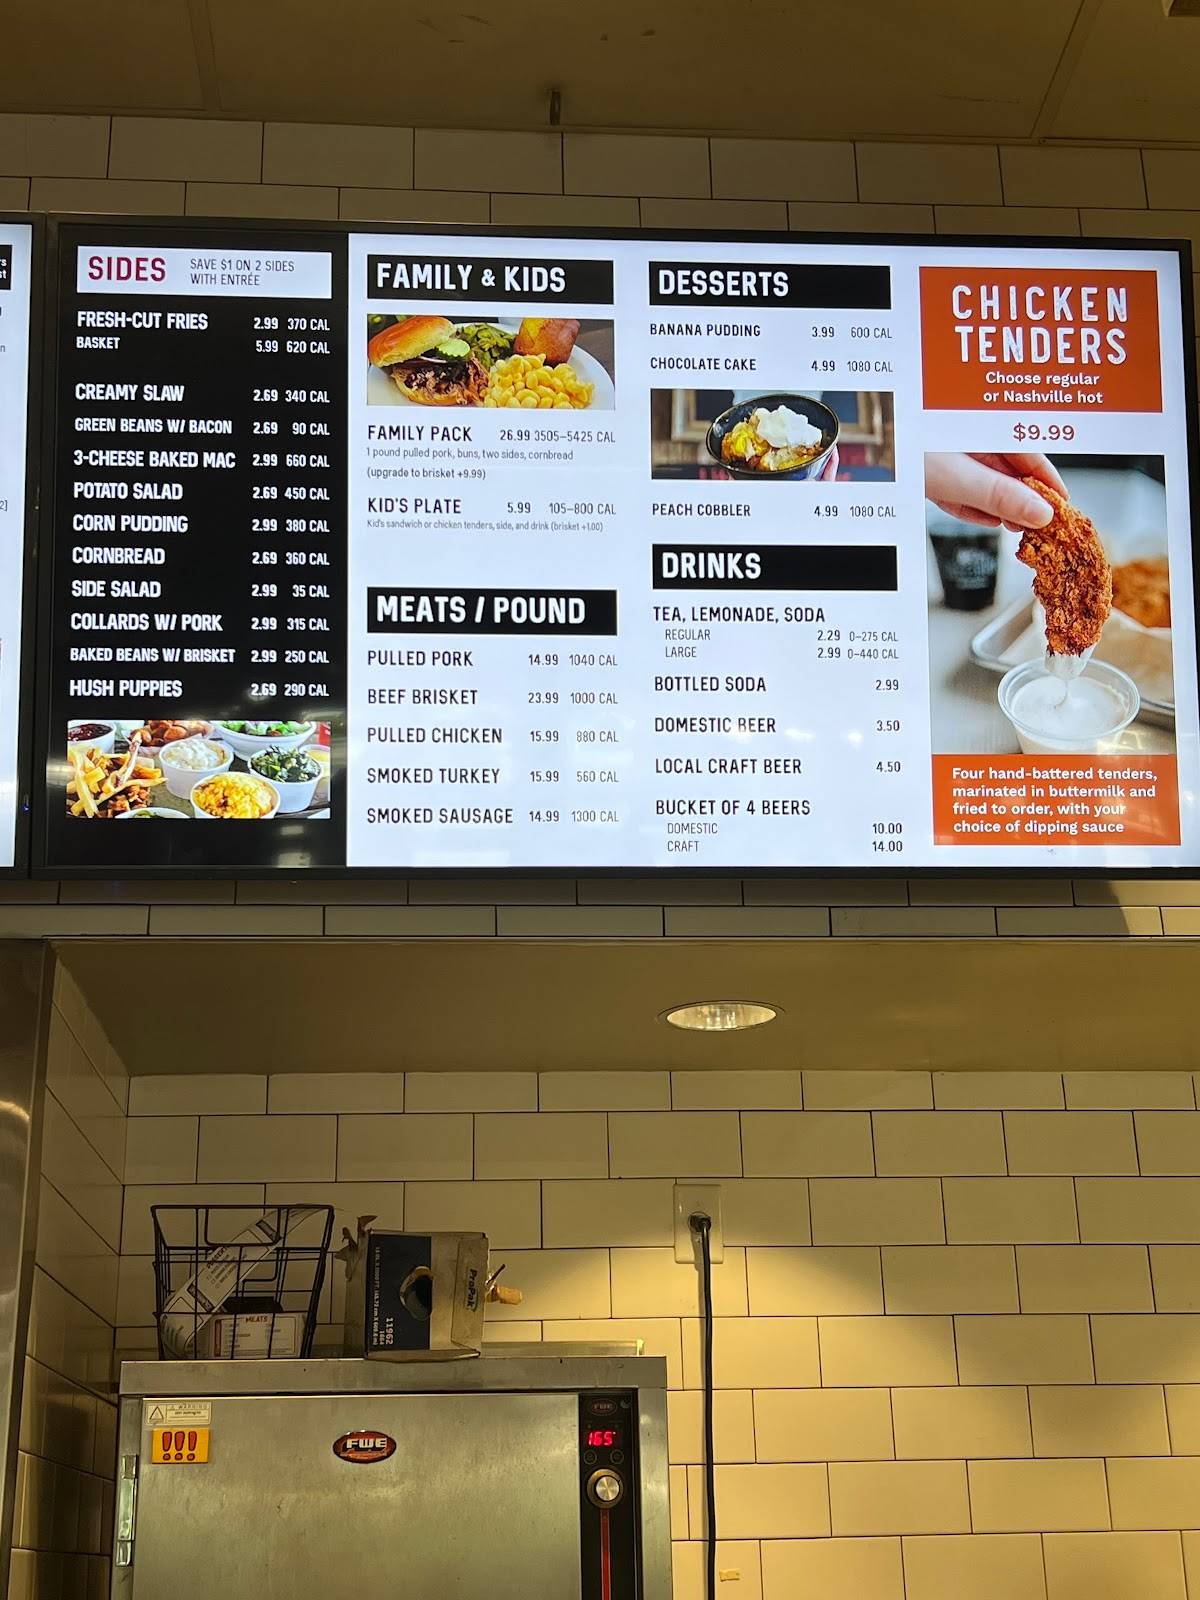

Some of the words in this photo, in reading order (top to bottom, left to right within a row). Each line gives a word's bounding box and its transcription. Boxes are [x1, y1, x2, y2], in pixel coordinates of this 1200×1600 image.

[88, 255, 166, 282] SIDES
[190, 258, 217, 270] SAVE
[220, 258, 232, 271] $1
[235, 259, 251, 271] ON
[255, 259, 262, 272] 2
[265, 260, 295, 272] SIDES
[190, 272, 217, 285] WITH
[220, 271, 260, 286] ENTRÉE
[377, 262, 473, 291] FAMILY
[481, 268, 496, 287] &
[504, 265, 566, 293] KIDS
[658, 269, 789, 297] DESSERTS
[952, 284, 1128, 323] CHICKEN
[77, 310, 163, 329] FRESH-CUT
[166, 312, 209, 331] FRIES
[253, 316, 279, 330] 2.99
[287, 317, 308, 331] 370
[309, 318, 331, 331] CAL
[650, 323, 702, 336] BANANA
[706, 323, 761, 337] PUDDING
[811, 326, 835, 338] 3.99
[76, 336, 121, 350] BASKET
[255, 339, 279, 353] 5.99
[286, 340, 307, 354] 620
[954, 325, 1127, 365] TENDERS
[650, 356, 721, 370] CHOCOLATE
[724, 357, 757, 371] CAKE
[810, 359, 836, 372] 4.99
[985, 370, 1042, 385] Choose
[1045, 372, 1100, 388] regular
[75, 382, 139, 401] CREAMY
[142, 384, 185, 402] SLAW
[253, 388, 279, 402] 2.69
[983, 392, 1000, 402] or
[1003, 389, 1073, 403] Nashville
[1077, 390, 1104, 404] hot
[74, 417, 116, 432] GREEN
[119, 417, 164, 433] BEANS
[166, 418, 186, 434] W/
[188, 419, 233, 434] BACON
[368, 424, 425, 441] FAMILY
[430, 426, 473, 442] PACK
[499, 429, 531, 442] 26.99
[1013, 422, 1075, 443] $9.99
[73, 449, 145, 467] 3-CHEESE
[148, 450, 199, 468] BAKED
[202, 451, 236, 469] MAC
[366, 446, 370, 457] 1
[372, 446, 401, 459] pound
[403, 447, 430, 460] pulled
[432, 447, 456, 461] pork,
[457, 447, 481, 461] buns,
[482, 449, 500, 459] two
[500, 448, 527, 461] sides,
[528, 449, 574, 461] cornbread
[366, 466, 409, 479] (upgrade
[411, 468, 420, 478] to
[422, 467, 455, 479] brisket
[456, 468, 486, 481] +9.99)
[73, 481, 129, 500] POTATO
[132, 482, 184, 500] SALAD
[368, 497, 409, 514] KID'S
[414, 498, 462, 514] PLATE
[507, 501, 531, 514] 5.99
[652, 503, 693, 516] PEACH
[697, 503, 751, 517] COBBLER
[72, 513, 116, 532] CORN
[120, 514, 189, 533] PUDDING
[367, 519, 385, 528] Kid's
[386, 519, 422, 529] sandwich
[424, 521, 431, 529] or
[433, 519, 462, 529] chicken
[463, 520, 495, 531] tenders,
[496, 520, 514, 531] side,
[515, 521, 529, 530] and
[530, 520, 549, 530] drink
[551, 520, 580, 531] (brisket
[72, 546, 166, 565] CORNBREAD
[662, 551, 762, 580] DRINKS
[71, 579, 107, 598] SIDE
[110, 580, 162, 598] SALAD
[376, 595, 467, 624] MEATS
[474, 595, 486, 624] /
[493, 596, 586, 624] POUND
[652, 606, 686, 623] TEA,
[691, 606, 779, 624] LEMONADE,
[784, 606, 825, 623] SODA
[70, 612, 150, 631] COLLARDS
[153, 613, 178, 631] W/
[181, 613, 224, 632] PORK
[664, 628, 711, 641] REGULAR
[817, 629, 841, 642] 2.29
[69, 647, 113, 662] BAKED
[115, 647, 159, 662] BEANS
[161, 647, 181, 663] W/
[183, 648, 236, 663] BRISKET
[367, 649, 426, 666] PULLED
[431, 650, 474, 667] PORK
[528, 653, 559, 666] 14.99
[665, 646, 697, 658] LARGE
[69, 678, 115, 697] HUSH
[118, 679, 183, 698] PUPPIES
[654, 675, 720, 692] BOTTLED
[725, 676, 767, 692] SODA
[367, 688, 406, 705] BEEF
[412, 688, 478, 705] BRISKET
[527, 691, 559, 704] 23.99
[654, 716, 732, 733] DOMESTIC
[737, 717, 776, 733] BEER
[876, 719, 900, 732] 3.50
[367, 727, 426, 743] PULLED
[431, 727, 503, 744] CHICKEN
[655, 758, 703, 774] LOCAL
[708, 758, 758, 774] CRAFT
[763, 758, 802, 774] BEER
[875, 760, 901, 773] 4.50
[952, 767, 985, 780] Four
[988, 766, 1094, 780] hand-battered
[1097, 767, 1158, 782] tenders,
[367, 767, 433, 784] SMOKED
[438, 767, 500, 784] TURKEY
[952, 784, 1027, 798] marinated
[1030, 784, 1045, 798] in
[1048, 784, 1126, 799] buttermilk
[1129, 784, 1156, 798] and
[367, 807, 433, 824] SMOKED
[439, 807, 513, 824] SAUSAGE
[656, 799, 716, 816] BUCKET
[721, 799, 741, 816] OF
[746, 799, 756, 816] 4
[761, 799, 811, 816] BEERS
[952, 801, 988, 815] fried
[990, 803, 1007, 815] to
[1010, 801, 1054, 817] order,
[1056, 801, 1090, 815] with
[1093, 803, 1127, 818] your
[667, 822, 718, 835] DOMESTIC
[872, 822, 903, 835] 10.00
[953, 819, 1002, 833] choice
[1005, 819, 1021, 833] of
[1024, 819, 1079, 836] dipping
[1081, 823, 1125, 833] sauce
[667, 840, 700, 853] CRAFT
[871, 840, 903, 852] 14.00
[385, 1317, 394, 1345] 11962
[346, 1437, 388, 1449] FWE
[588, 1431, 613, 1446] 165
